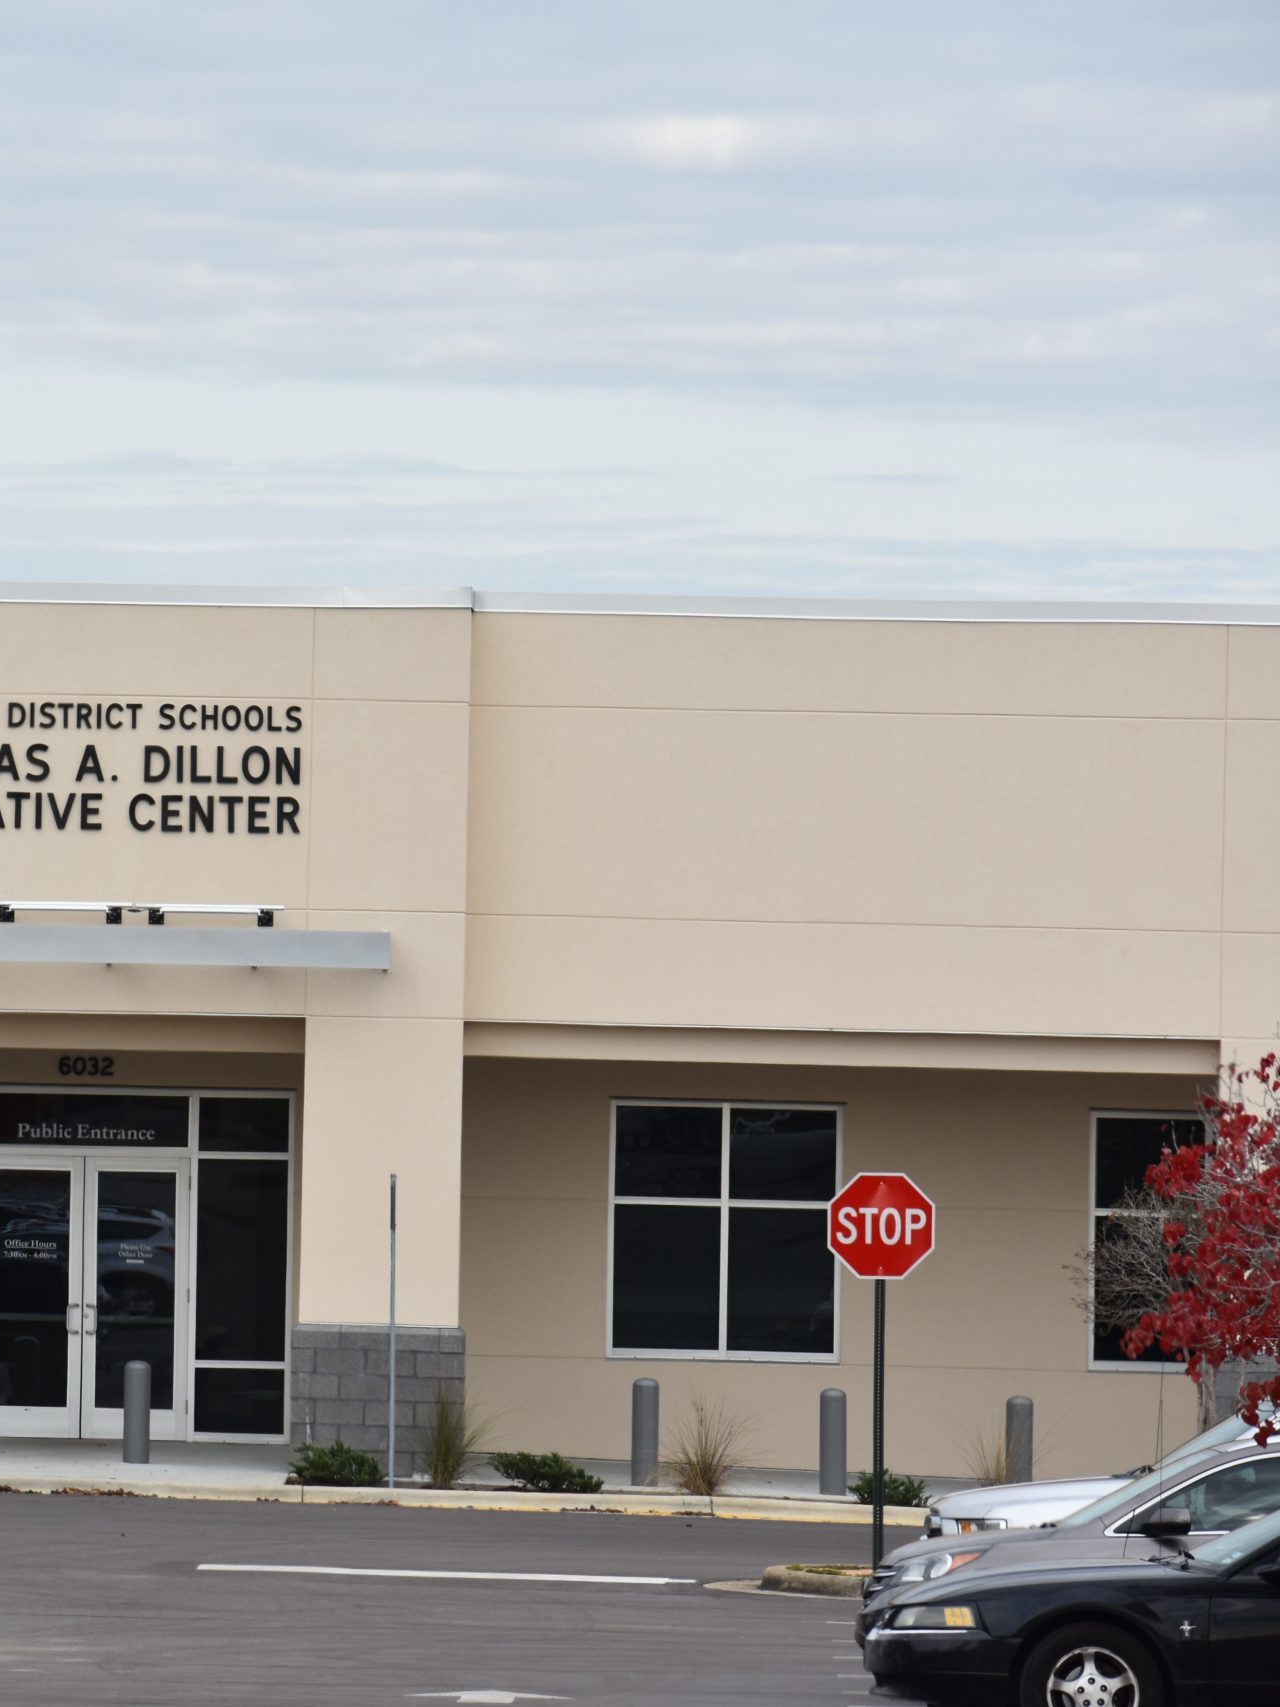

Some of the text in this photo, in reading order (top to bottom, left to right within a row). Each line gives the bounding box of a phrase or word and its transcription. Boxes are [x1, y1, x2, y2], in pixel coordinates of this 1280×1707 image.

[7, 702, 143, 730] DISTRICT
[158, 703, 303, 733] SCHOOLS
[75, 744, 119, 783] A.
[143, 745, 301, 786] DILLON
[128, 793, 300, 835] CENTER
[58, 1056, 114, 1076] 6032
[17, 1122, 156, 1141] Public Entrance
[836, 1206, 927, 1246] STOP
[4, 1239, 57, 1249] Office Hours
